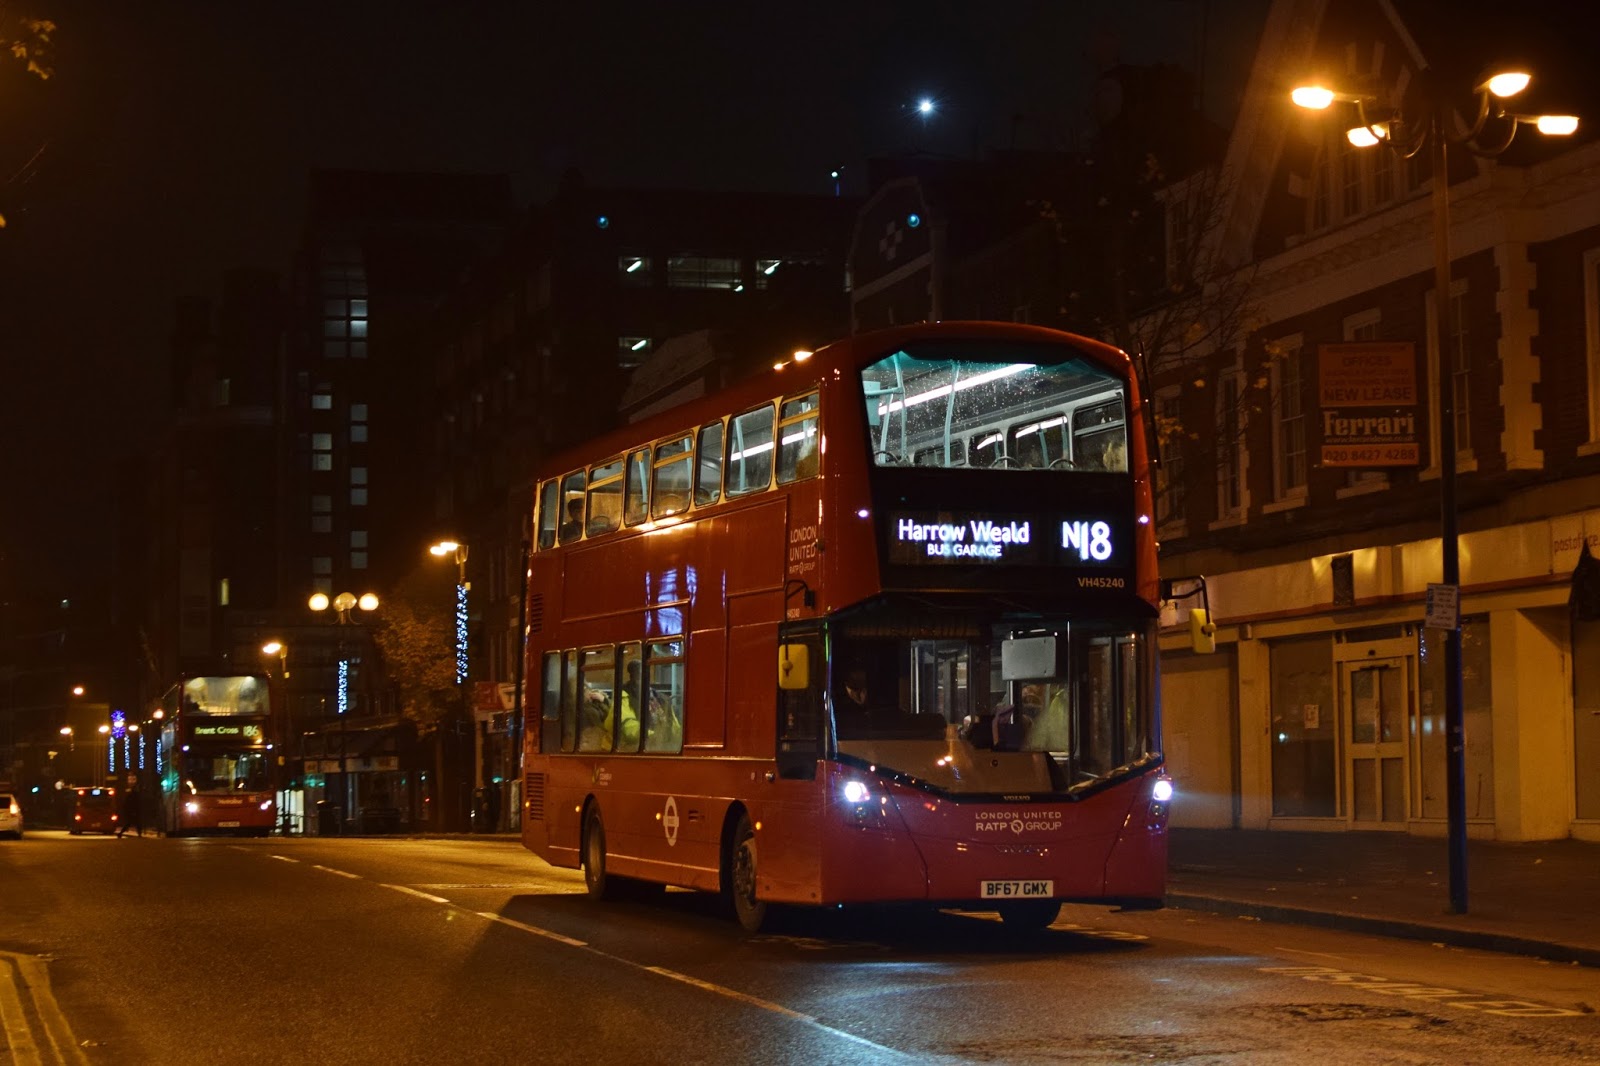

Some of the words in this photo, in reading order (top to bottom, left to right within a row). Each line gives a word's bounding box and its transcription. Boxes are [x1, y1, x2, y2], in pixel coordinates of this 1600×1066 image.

[1324, 388, 1360, 402] NEW
[1363, 386, 1413, 400] LEASE
[1322, 410, 1415, 436] Ferrari
[1324, 451, 1347, 461] 020
[790, 525, 817, 544] LONDON
[899, 519, 965, 542] Harrow
[971, 520, 1030, 543] Weald
[1062, 521, 1112, 561] N18
[789, 542, 816, 562] UNITED
[927, 544, 950, 556] BUS
[953, 544, 1002, 558] GARAGE
[1078, 577, 1124, 588] VH45240
[195, 727, 216, 735] Brent
[217, 726, 239, 735] Cross
[975, 812, 1019, 820] LONDON
[1023, 811, 1062, 819] UNITED
[975, 822, 1008, 831] RATP
[1025, 821, 1062, 831] GROUP
[987, 883, 1020, 896] BF67
[1023, 882, 1048, 895] GMX
